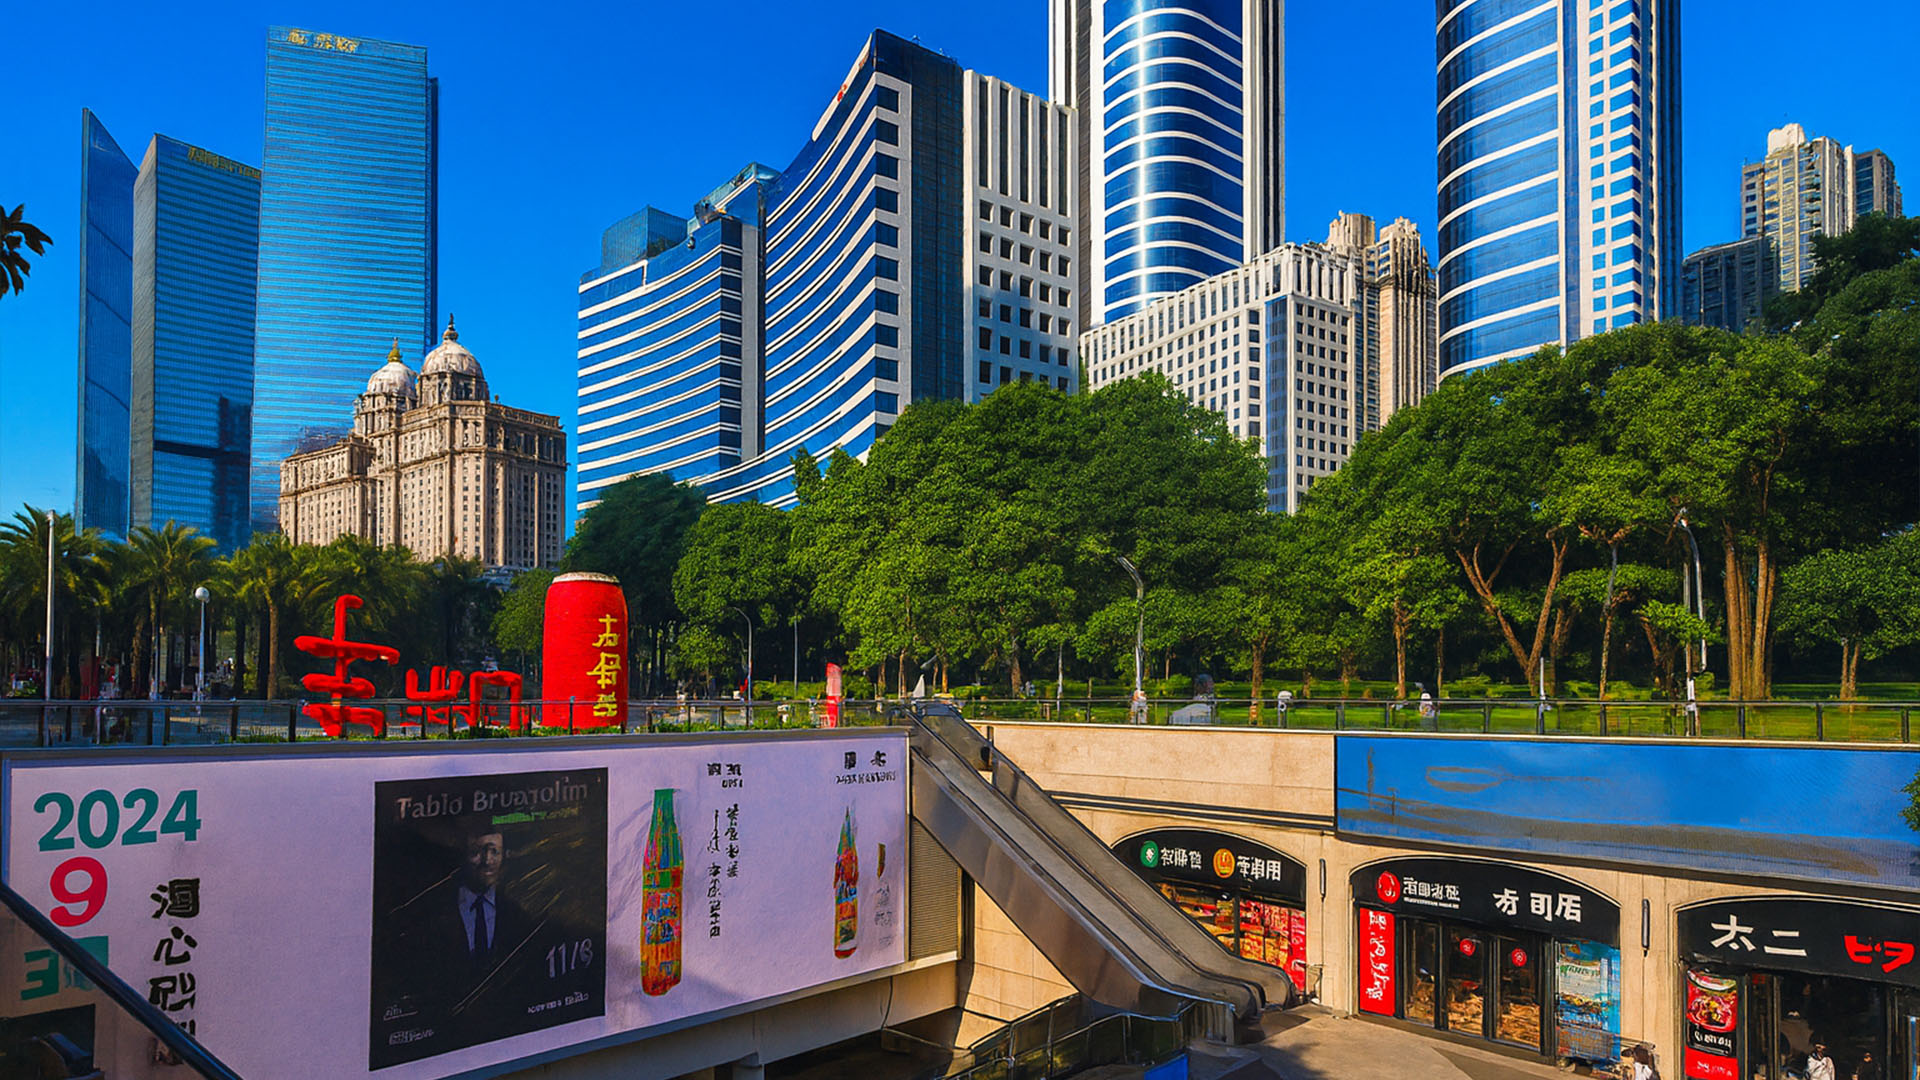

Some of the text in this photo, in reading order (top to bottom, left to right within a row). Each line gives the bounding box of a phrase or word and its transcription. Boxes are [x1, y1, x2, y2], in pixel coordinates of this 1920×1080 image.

[33, 788, 201, 852] 2024
[50, 856, 108, 927] 9
[1711, 914, 1807, 957] 太二
